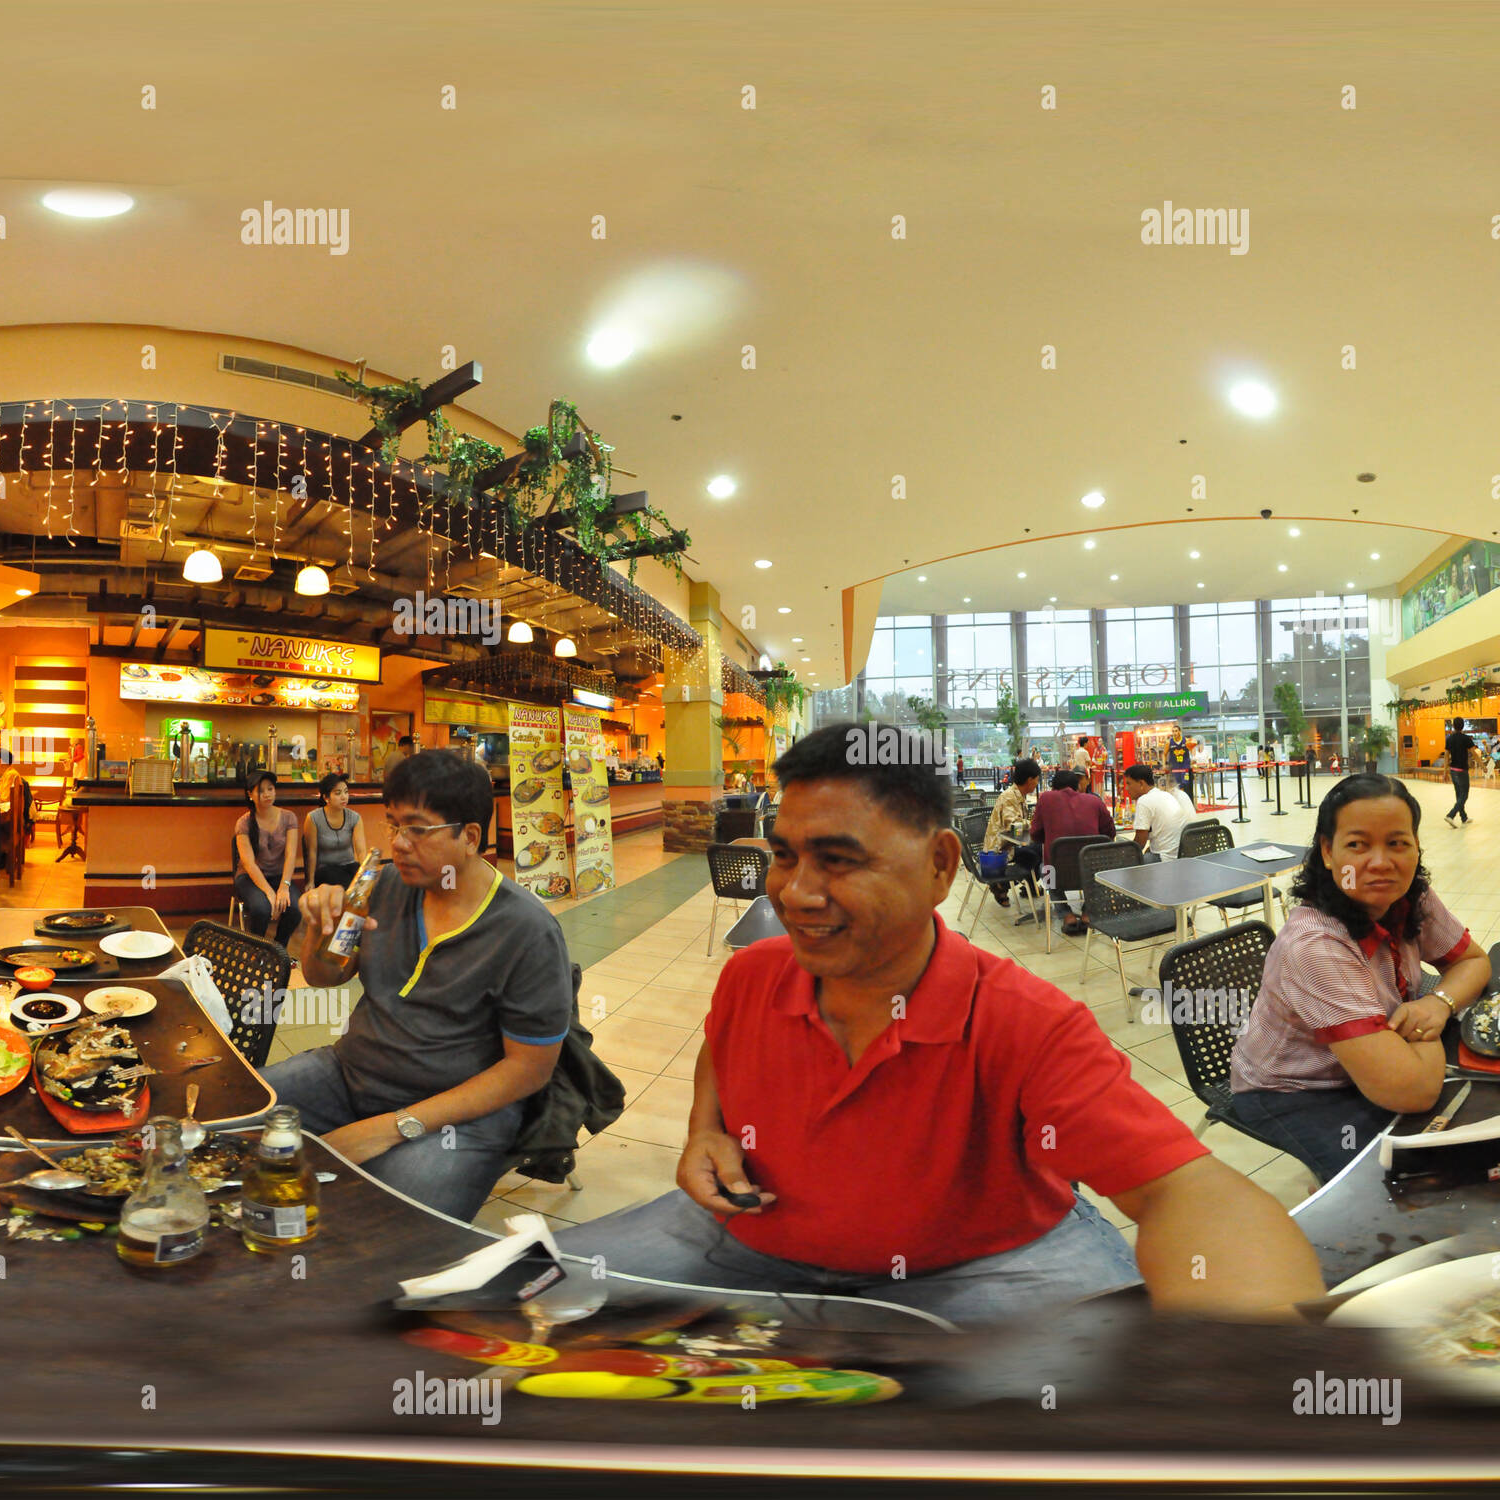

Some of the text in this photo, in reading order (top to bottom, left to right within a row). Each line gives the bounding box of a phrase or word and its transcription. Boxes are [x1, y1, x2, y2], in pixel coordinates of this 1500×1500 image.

[251, 636, 356, 666] NANUK'S
[240, 659, 353, 676] STEAK HOUSE
[1080, 702, 1110, 712] THANK
[1112, 701, 1130, 710] YOU
[1133, 700, 1152, 710] FOR
[514, 707, 558, 724] NANUK'S
